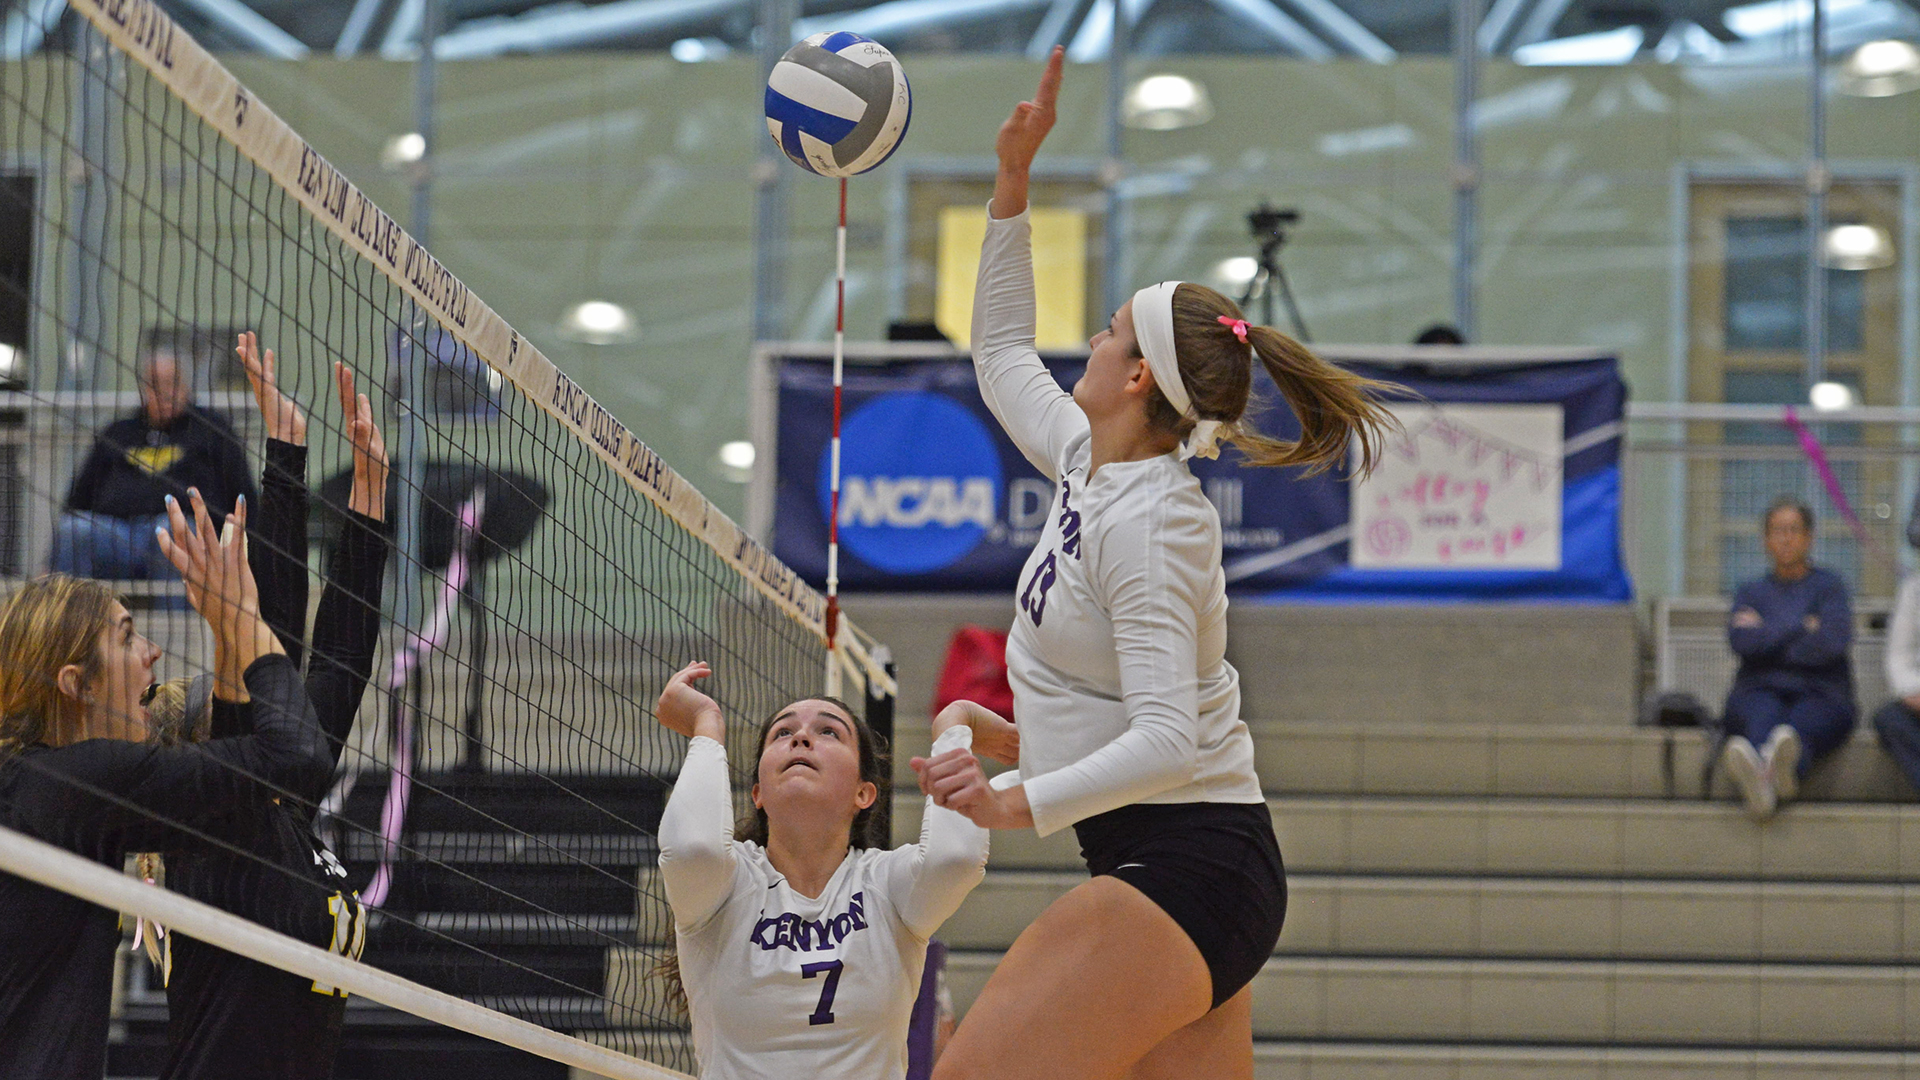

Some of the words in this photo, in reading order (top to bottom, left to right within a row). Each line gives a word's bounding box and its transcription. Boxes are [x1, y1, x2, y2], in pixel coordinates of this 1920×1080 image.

[838, 475, 995, 528] NCAA
[1020, 548, 1057, 628] 13
[750, 891, 868, 952] KENYON
[800, 958, 844, 1026] 7
